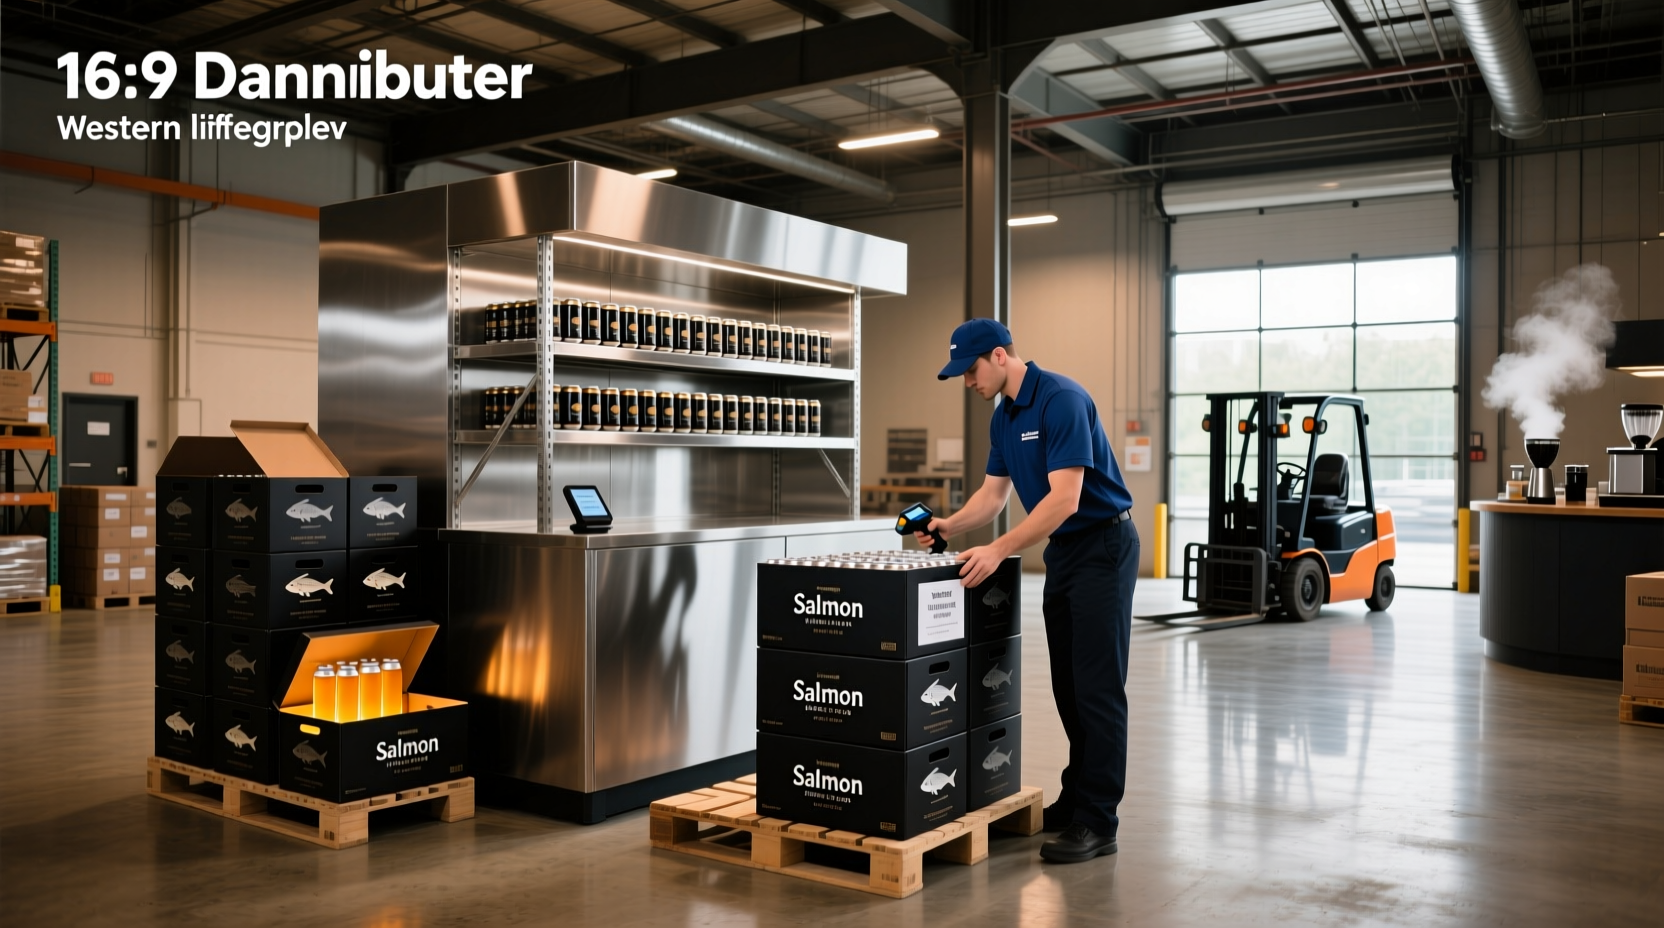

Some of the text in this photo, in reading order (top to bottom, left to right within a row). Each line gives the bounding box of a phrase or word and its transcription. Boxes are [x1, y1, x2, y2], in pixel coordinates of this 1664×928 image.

[793, 592, 864, 619] Salmon
[793, 679, 863, 708] Salmon
[375, 737, 439, 762] Salmon
[793, 764, 863, 796] Salmon
